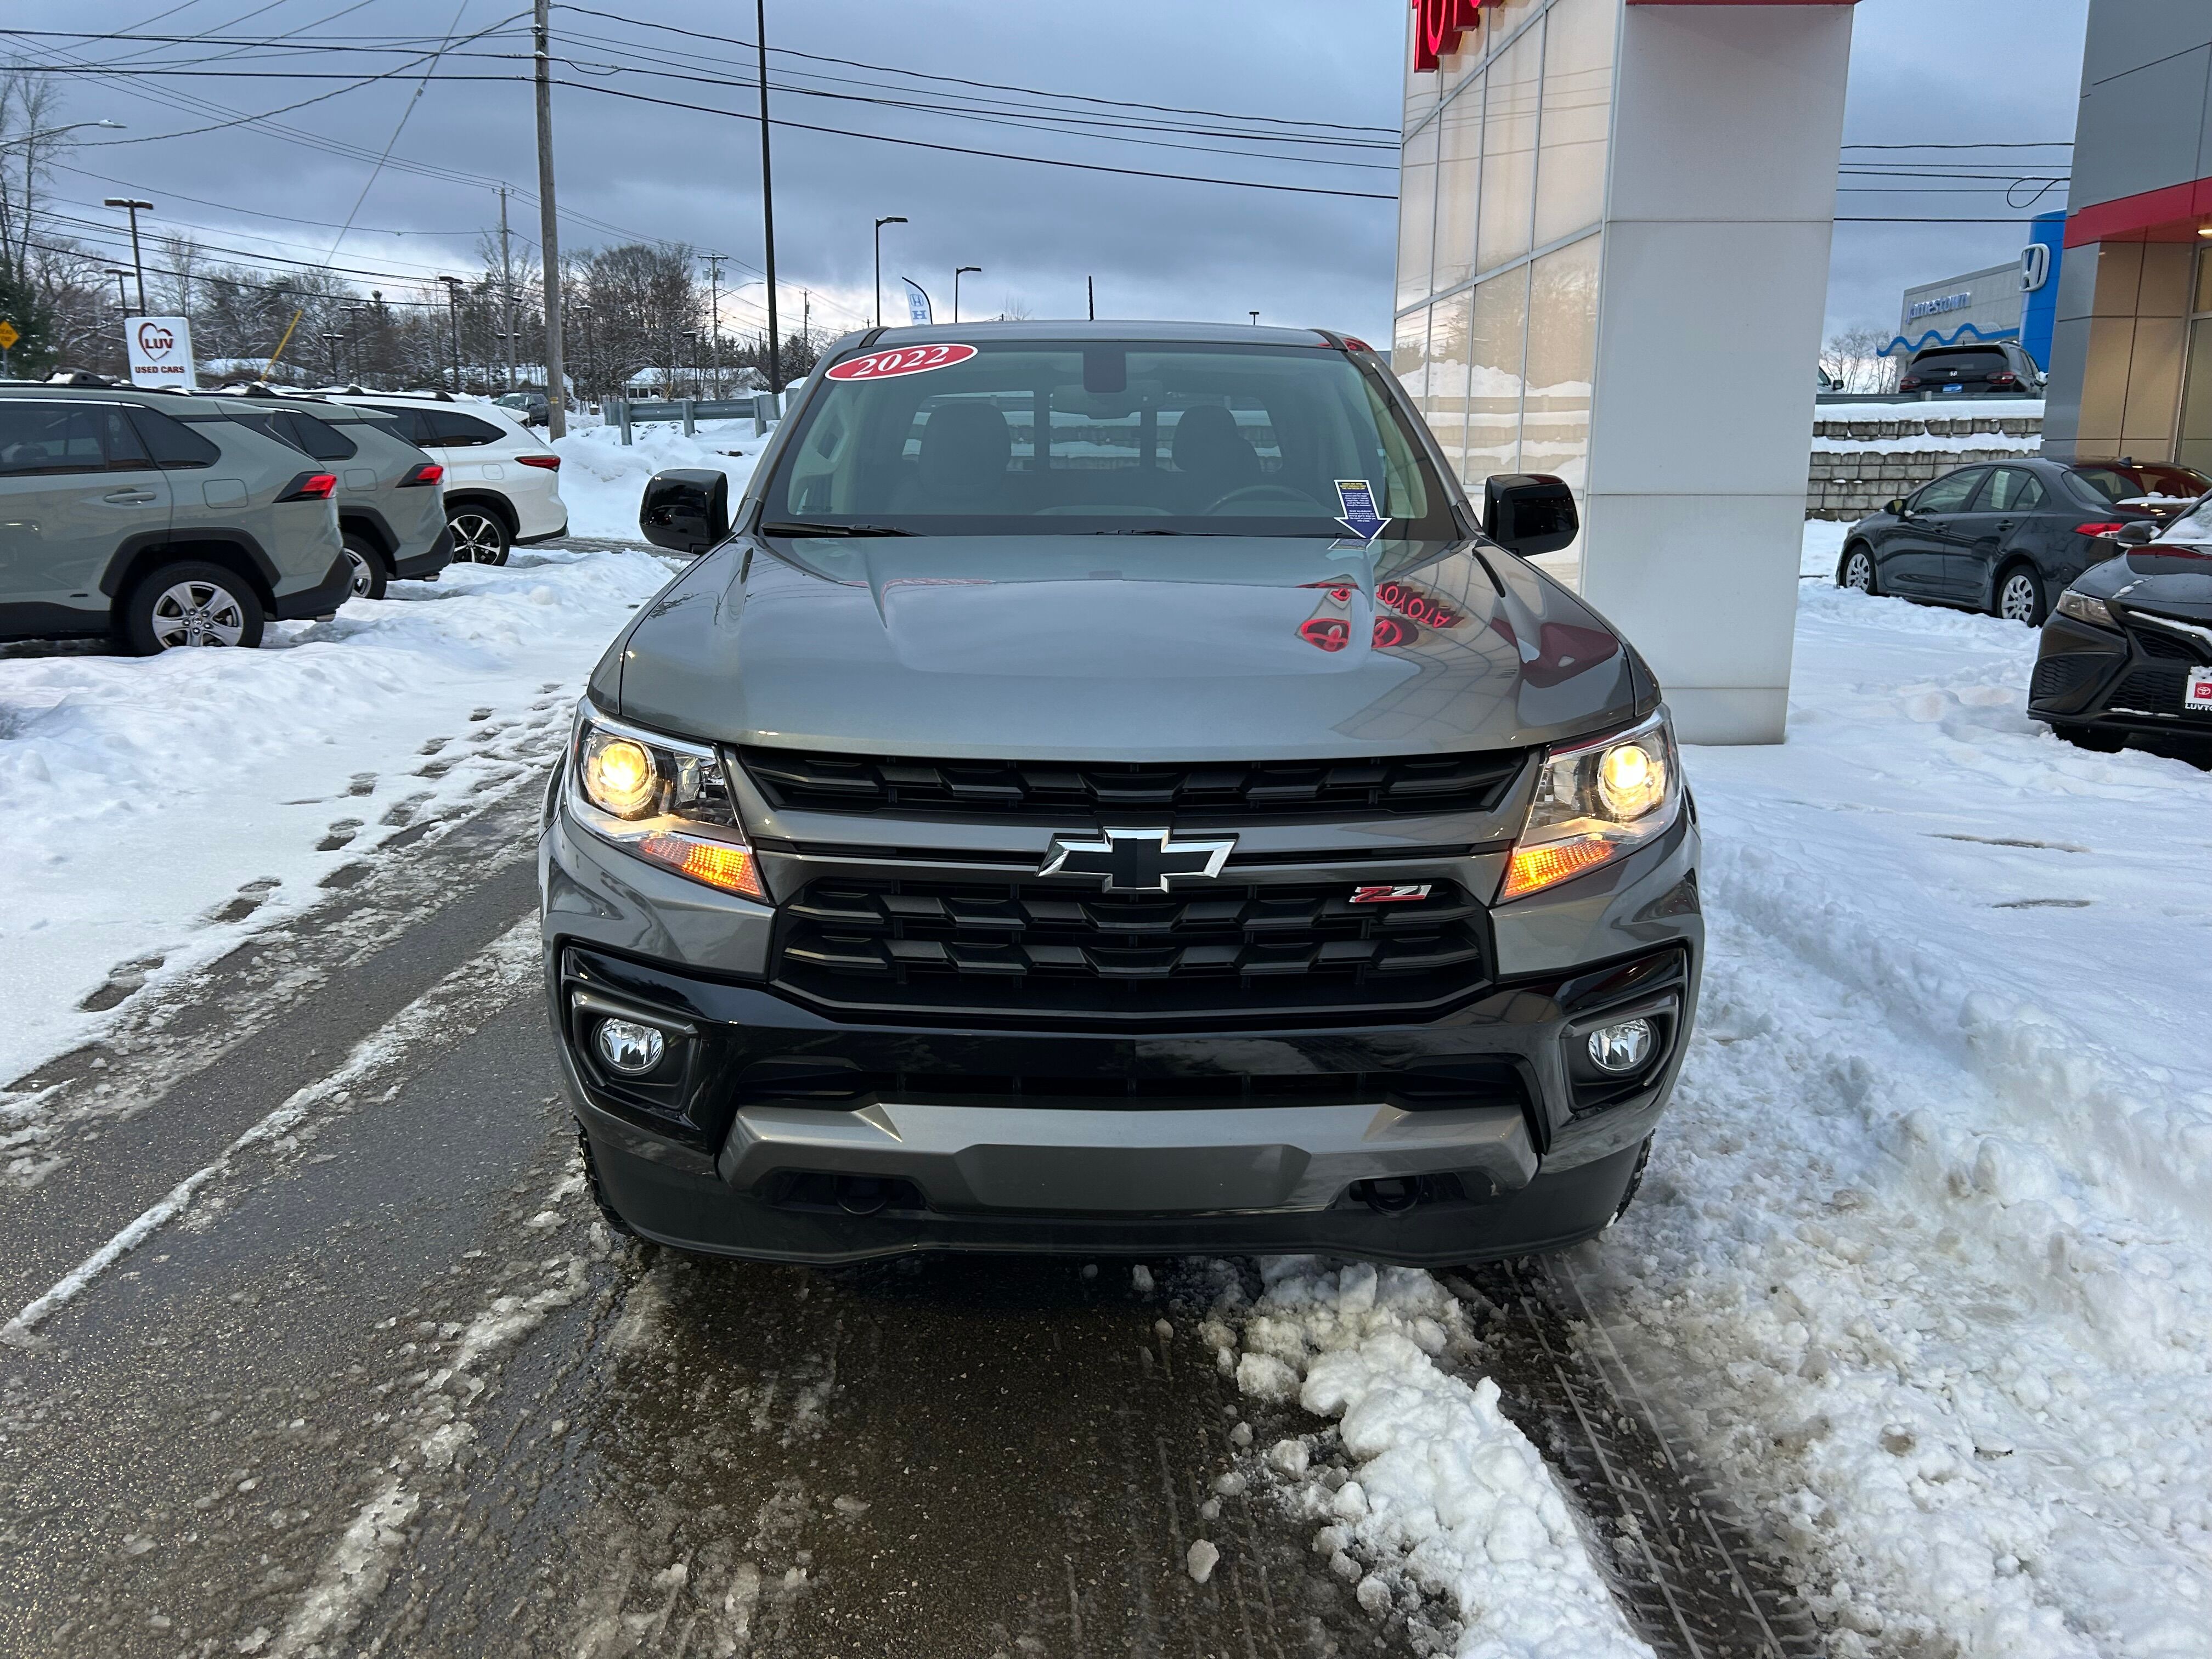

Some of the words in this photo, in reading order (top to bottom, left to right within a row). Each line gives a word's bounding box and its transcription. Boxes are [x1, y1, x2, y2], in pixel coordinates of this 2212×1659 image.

[1906, 292, 1971, 325] Jamestown
[145, 338, 173, 348] LUV
[851, 346, 950, 377] 2022
[1348, 885, 1432, 902] Z71
